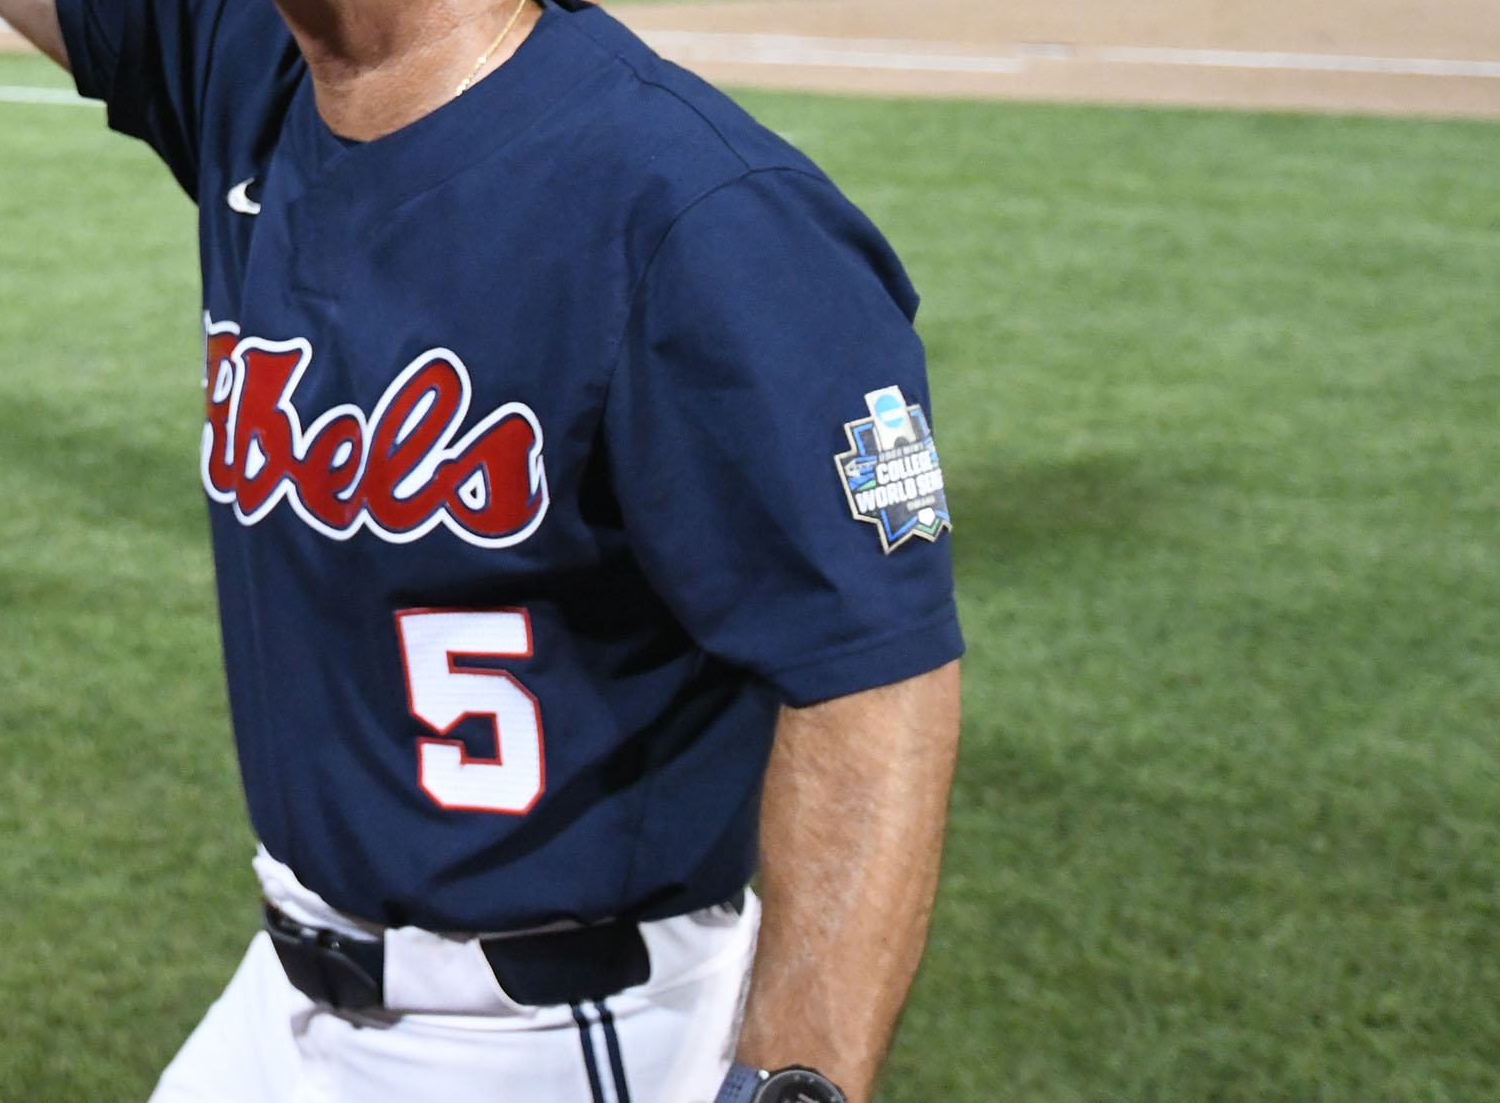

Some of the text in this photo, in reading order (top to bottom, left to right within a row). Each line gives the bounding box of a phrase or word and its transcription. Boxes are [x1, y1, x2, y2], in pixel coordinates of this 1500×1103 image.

[201, 309, 550, 549] bels
[855, 477, 918, 513] WORLD
[394, 606, 546, 815] 5
